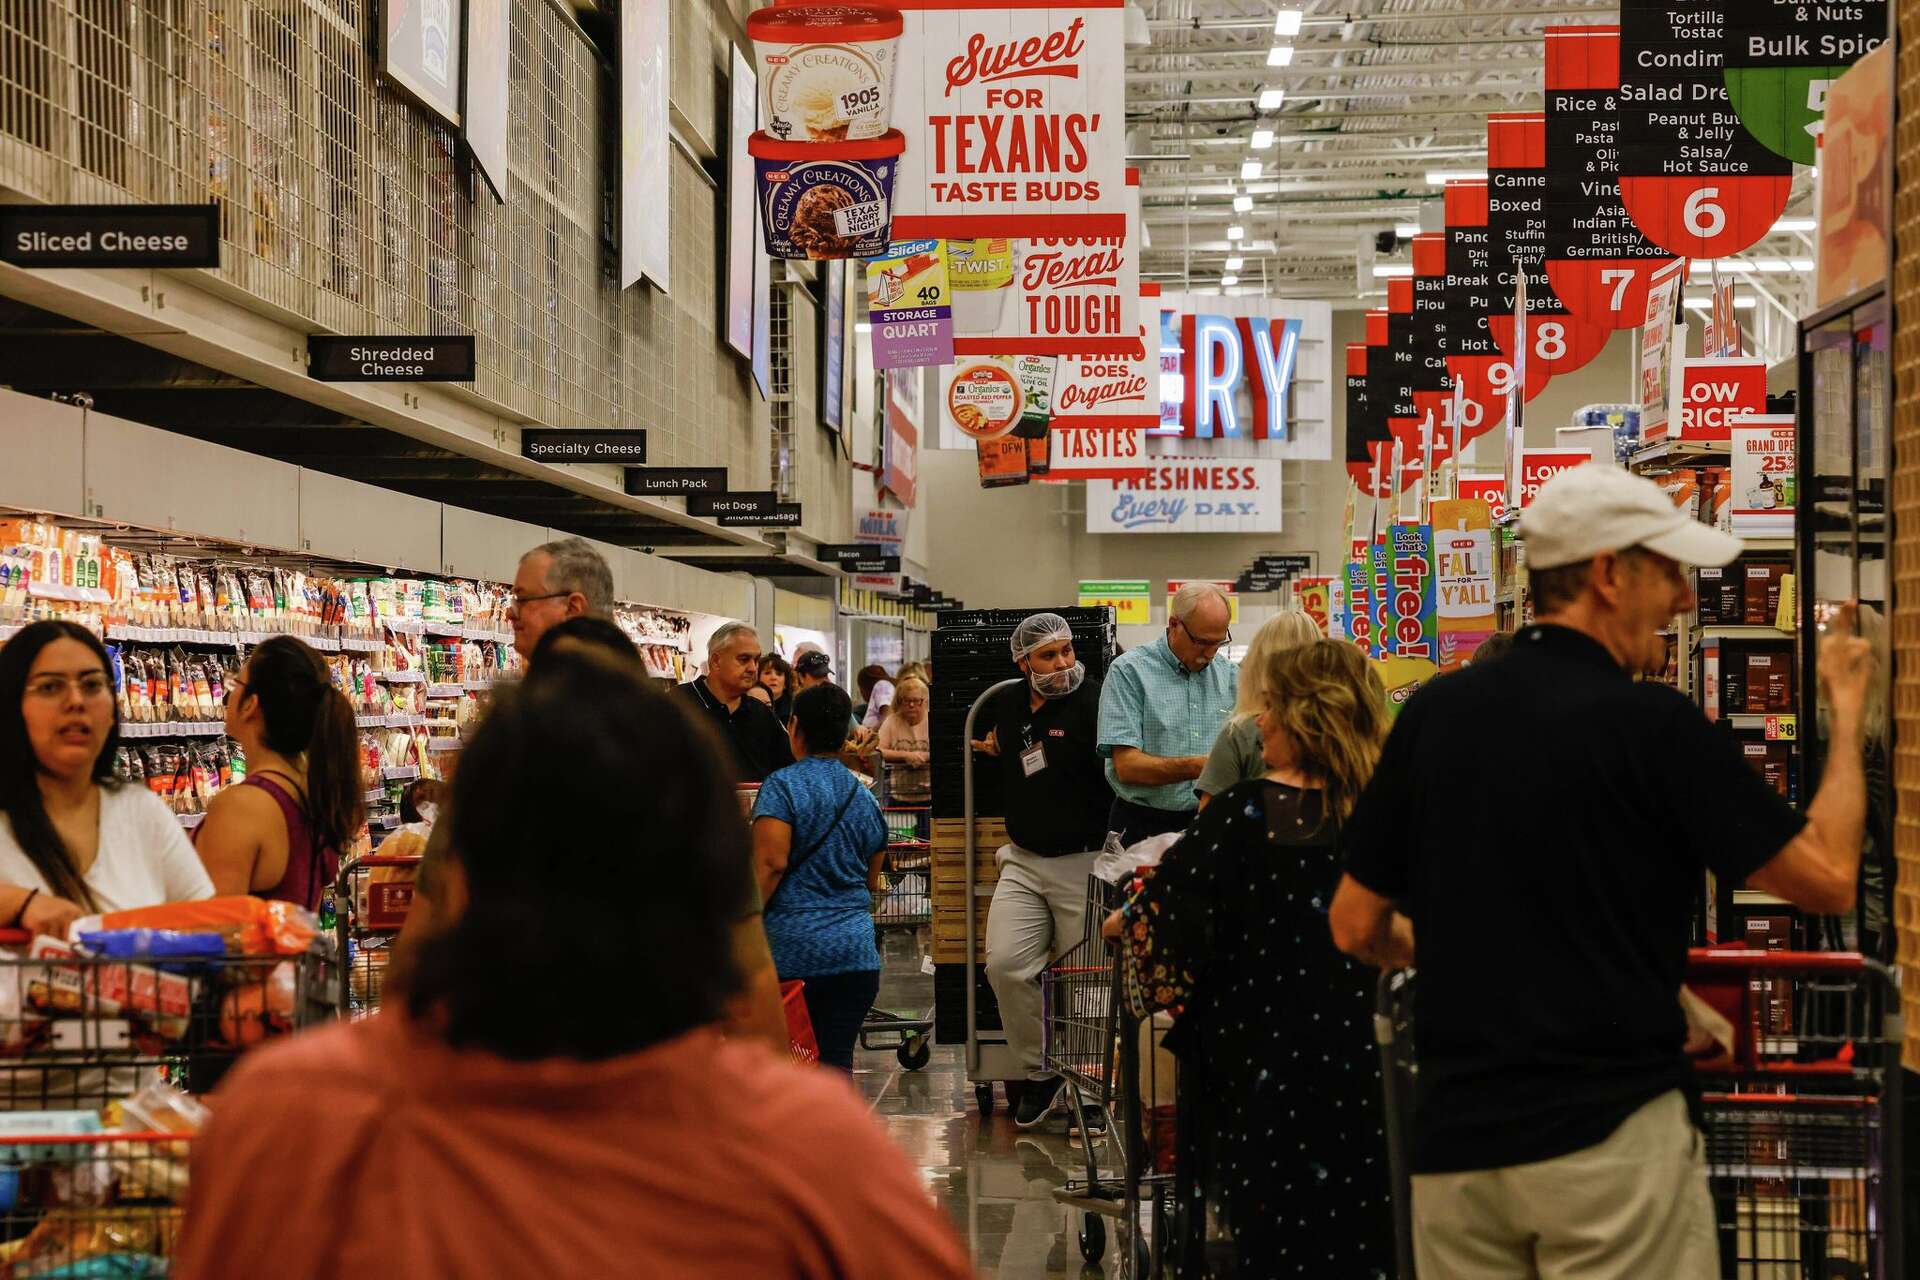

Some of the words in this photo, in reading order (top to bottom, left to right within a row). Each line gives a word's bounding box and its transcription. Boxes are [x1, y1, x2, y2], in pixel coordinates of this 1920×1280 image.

[1795, 7, 1808, 21] &
[1817, 6, 1863, 21] Nuts
[1749, 35, 1809, 56] Bulk
[1820, 34, 1888, 59] Spic
[945, 17, 1084, 97] Sweet
[803, 54, 868, 83] CREATIONS
[841, 86, 880, 110] 1905
[987, 89, 1043, 108] FOR
[1620, 84, 1682, 101] Salad
[846, 103, 880, 117] VANILLA
[1555, 97, 1597, 111] Rice
[1604, 96, 1617, 111] &
[1648, 113, 1705, 125] Peanut
[1576, 134, 1614, 144] Pasta
[1678, 127, 1688, 139] &
[1695, 127, 1734, 141] Jelly
[929, 114, 1100, 174] TEXANS'
[1680, 144, 1732, 159] Salsa/
[1586, 161, 1595, 172] &
[1663, 161, 1692, 172] Hot
[1700, 161, 1749, 172] Sauce
[1495, 174, 1546, 187] Canne
[931, 181, 1017, 203] TASTE
[1030, 181, 1100, 202] BUDS
[1580, 181, 1622, 196] Vine
[776, 179, 801, 230] CREAMY
[803, 170, 870, 202] CREATIONS
[1489, 199, 1541, 211] Boxed
[844, 203, 880, 218] TEXAS
[1595, 206, 1629, 216] Asia
[1683, 187, 1726, 238] 6
[847, 212, 880, 225] STARRY
[1573, 218, 1616, 229] Indian
[848, 219, 880, 233] NIGHT
[1505, 230, 1545, 239] Stuffin
[1591, 233, 1644, 245] British/
[17, 232, 92, 252] Sliced
[100, 232, 189, 252] Cheese
[1507, 244, 1546, 254] Canne
[888, 241, 932, 258] Slider
[1566, 246, 1621, 256] German
[1512, 254, 1546, 264] Fish/
[1023, 249, 1124, 290] Texas
[1416, 280, 1444, 291] Baki
[1447, 274, 1488, 286] Break
[917, 286, 940, 300] 40
[1601, 270, 1635, 311] 7
[1416, 299, 1445, 310] Flou
[1504, 296, 1562, 311] Vgeta
[883, 310, 937, 321] STORAGE
[1026, 294, 1120, 334] TOUGH
[883, 323, 938, 339] QUART
[1461, 339, 1488, 351] Hot
[1535, 322, 1566, 360] 8
[350, 347, 434, 362] Shredded
[361, 363, 424, 376] Cheese
[1019, 360, 1051, 373] Organics
[1081, 365, 1128, 377] DOES
[1487, 362, 1515, 395] 9
[968, 384, 1000, 395] Organics
[1060, 374, 1147, 410] Organic
[1394, 404, 1417, 414] Salt
[1441, 398, 1483, 427] 10
[1682, 407, 1755, 428] RICE
[530, 443, 590, 456] Specialty
[595, 443, 641, 454] Cheese
[1001, 443, 1022, 454] DFW
[1060, 428, 1136, 457] TASTES
[1747, 440, 1775, 451] GRAND
[646, 479, 679, 488] Lunch
[682, 479, 708, 488] Pack
[713, 502, 731, 510] Hot
[733, 502, 758, 511] Dogs
[1111, 494, 1188, 523] Every
[1195, 503, 1259, 515] DAY.
[860, 518, 897, 535] MILK
[1396, 532, 1422, 541] Look
[1394, 542, 1427, 551] what's
[1439, 552, 1489, 576] FALL
[1441, 584, 1490, 605] Y'ALL
[1394, 555, 1430, 658] free!
